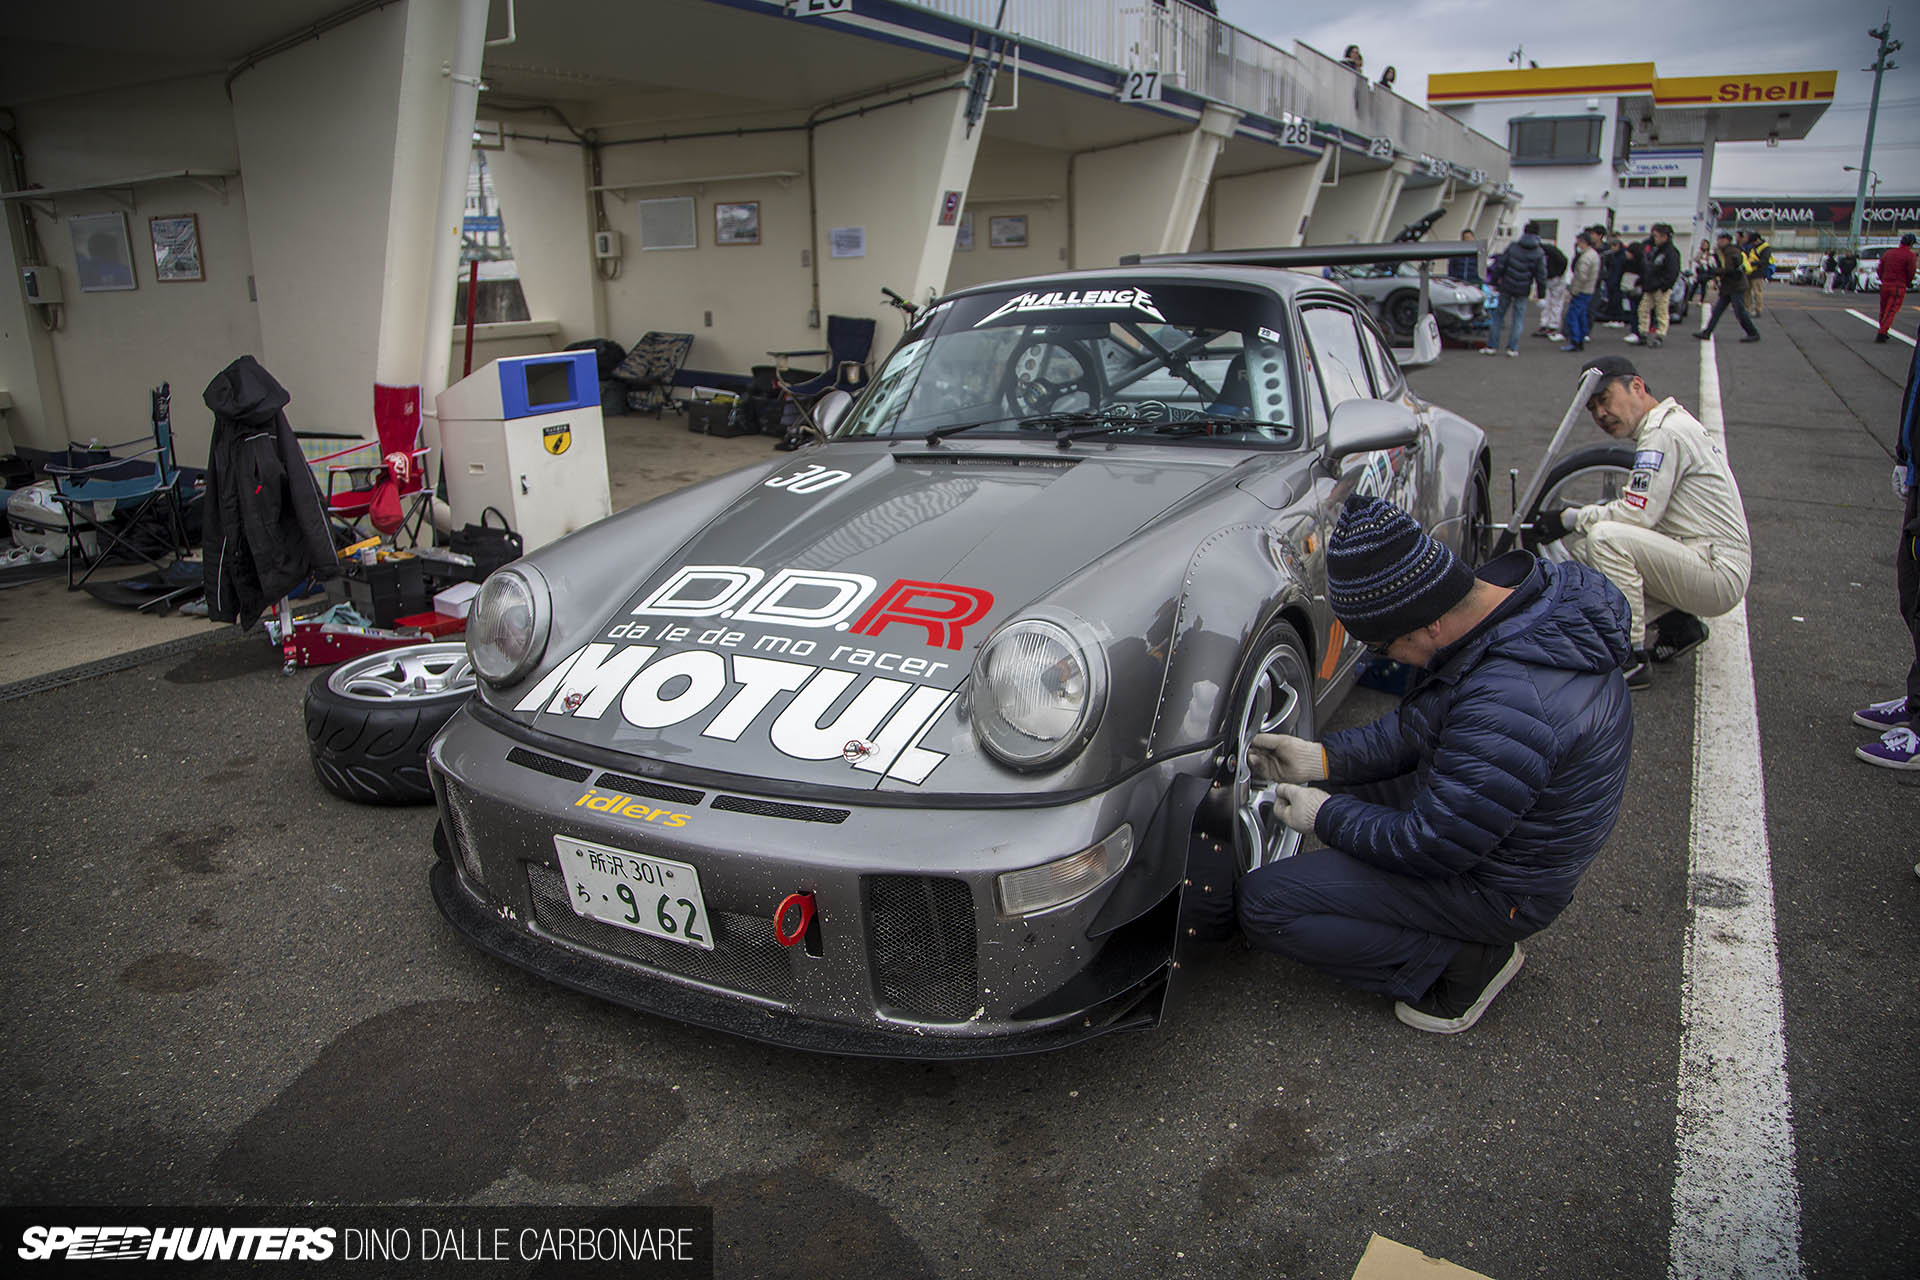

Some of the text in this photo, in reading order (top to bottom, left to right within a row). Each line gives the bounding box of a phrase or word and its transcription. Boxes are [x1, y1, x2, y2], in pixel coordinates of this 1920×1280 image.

[1130, 72, 1158, 99] 27
[1718, 81, 1809, 101] Shell
[1287, 124, 1308, 144] 28
[1374, 138, 1392, 156] 29
[1735, 207, 1815, 222] YOKOHAMA
[1863, 207, 1920, 222] OKOHA
[973, 287, 1167, 328] CHALLENGE
[764, 464, 852, 493] 30
[607, 621, 949, 678] da le de mo racer
[513, 643, 960, 786] MOTUL
[574, 789, 692, 828] idlers
